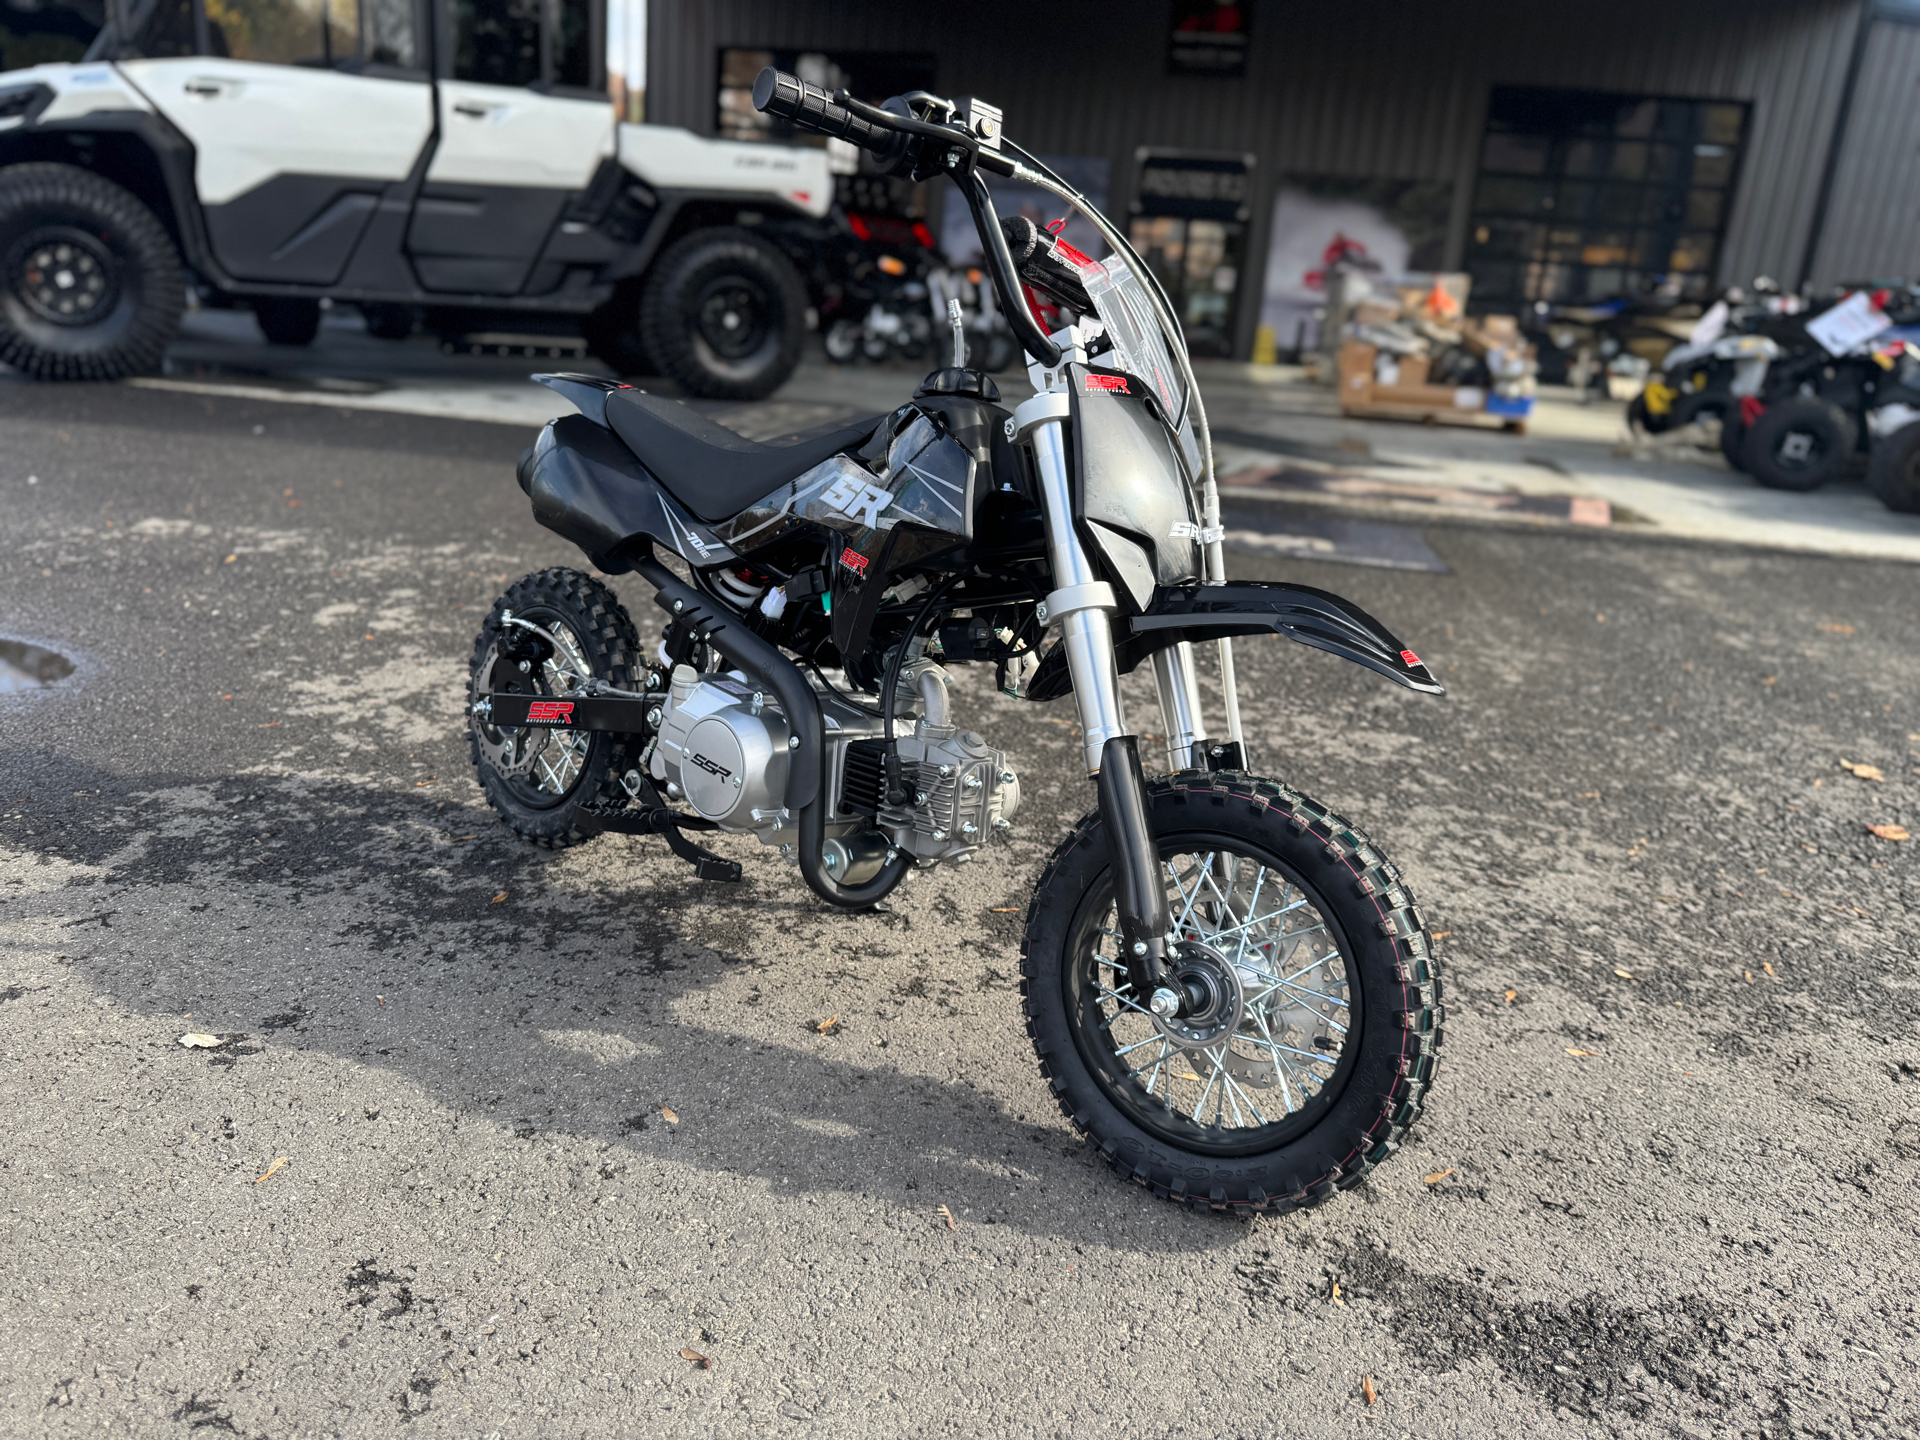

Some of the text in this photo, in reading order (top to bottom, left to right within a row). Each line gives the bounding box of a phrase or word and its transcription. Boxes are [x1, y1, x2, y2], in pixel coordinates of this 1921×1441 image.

[1085, 374, 1131, 395] SSR
[819, 473, 895, 531] SR
[840, 547, 869, 577] SSR
[528, 701, 575, 724] SSR
[690, 753, 732, 784] SSR
